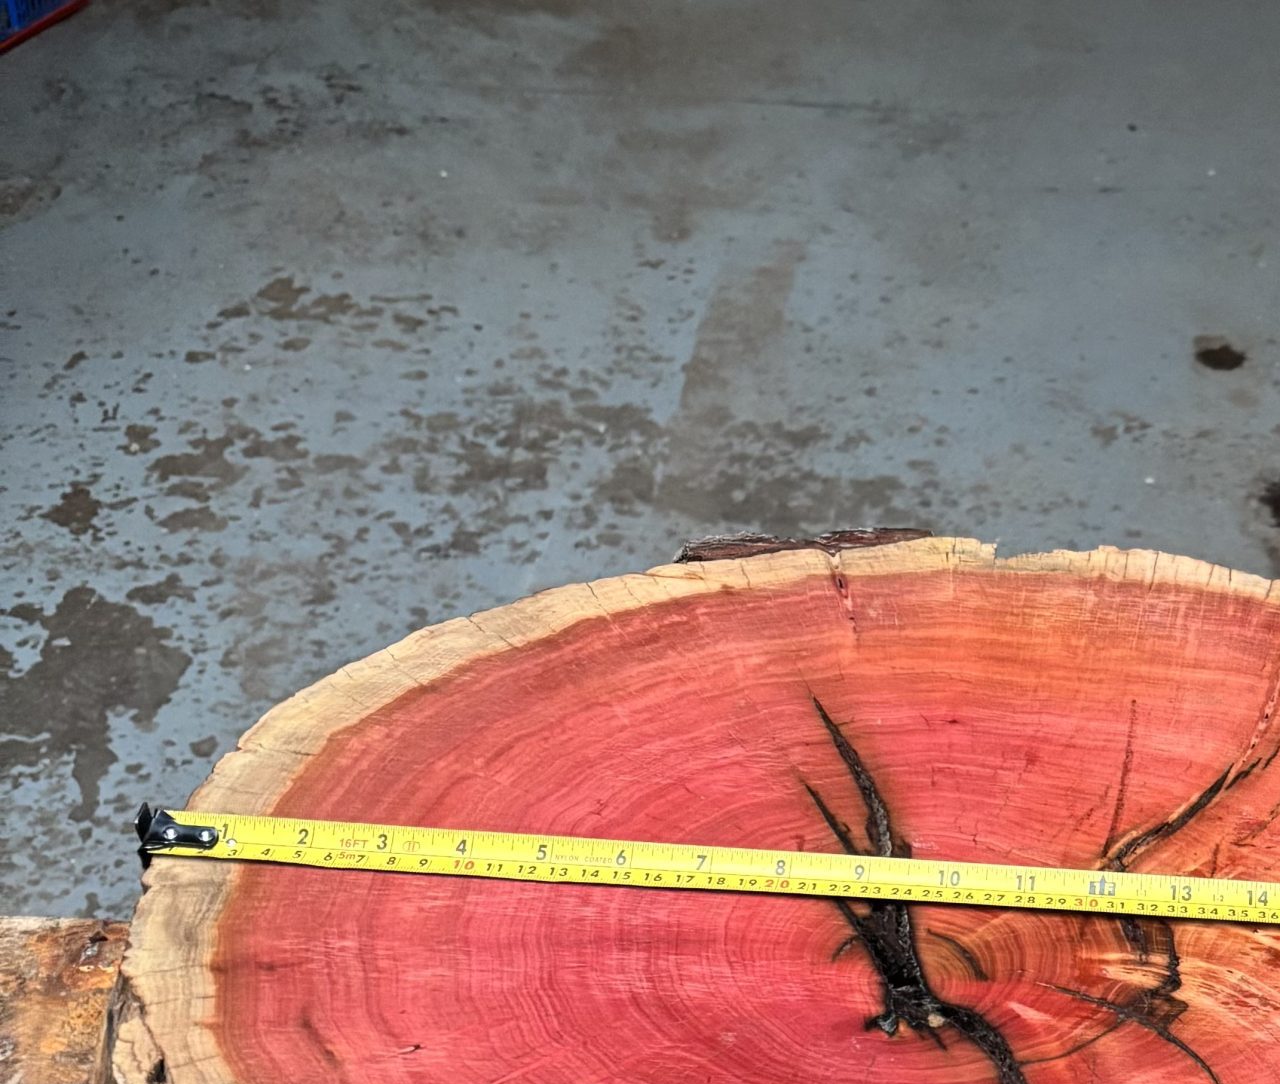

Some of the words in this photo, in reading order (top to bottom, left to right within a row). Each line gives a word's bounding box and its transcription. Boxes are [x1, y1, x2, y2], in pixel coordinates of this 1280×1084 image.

[339, 839, 368, 849] 16FT
[338, 851, 356, 860] 5m
[555, 854, 579, 862] NYLON
[585, 856, 613, 864] COATED
[220, 823, 229, 839] 1
[297, 829, 309, 845] 2
[377, 834, 388, 850] 3
[456, 840, 467, 855] 4
[536, 844, 548, 860] 5
[616, 849, 627, 865] 6
[696, 854, 707, 870] 7
[775, 859, 786, 875] 8
[854, 865, 865, 880] 9
[939, 870, 960, 886] 10
[1016, 875, 1036, 891] 11
[1170, 885, 1192, 901] 13
[1247, 890, 1268, 906] 14
[261, 848, 270, 856] 4
[323, 852, 333, 860] 6
[356, 854, 365, 863] 7
[387, 857, 396, 865] 8
[419, 859, 428, 867] 9
[453, 860, 475, 870] 10
[486, 863, 503, 872] 11
[518, 865, 537, 875] 12
[550, 867, 568, 877] 13
[581, 869, 599, 878] 14
[613, 871, 631, 880] 15
[644, 873, 662, 882] 16
[675, 875, 695, 883] 17
[707, 876, 726, 885] 18
[739, 878, 757, 887] 19
[765, 879, 789, 888] 20
[798, 882, 817, 891] 21
[829, 884, 851, 892] 22
[860, 886, 881, 894] 23
[891, 888, 912, 896] 24
[922, 890, 943, 898] 25
[953, 891, 974, 900] 26
[984, 893, 1005, 902] 27
[1015, 895, 1036, 904] 28
[1046, 897, 1066, 906] 29
[1074, 898, 1098, 908] 30
[1106, 901, 1125, 909] 31
[1137, 903, 1158, 911] 32
[1167, 905, 1188, 913] 33
[1198, 907, 1218, 915] 34
[1228, 909, 1248, 917] 35
[1259, 911, 1279, 919] 36
